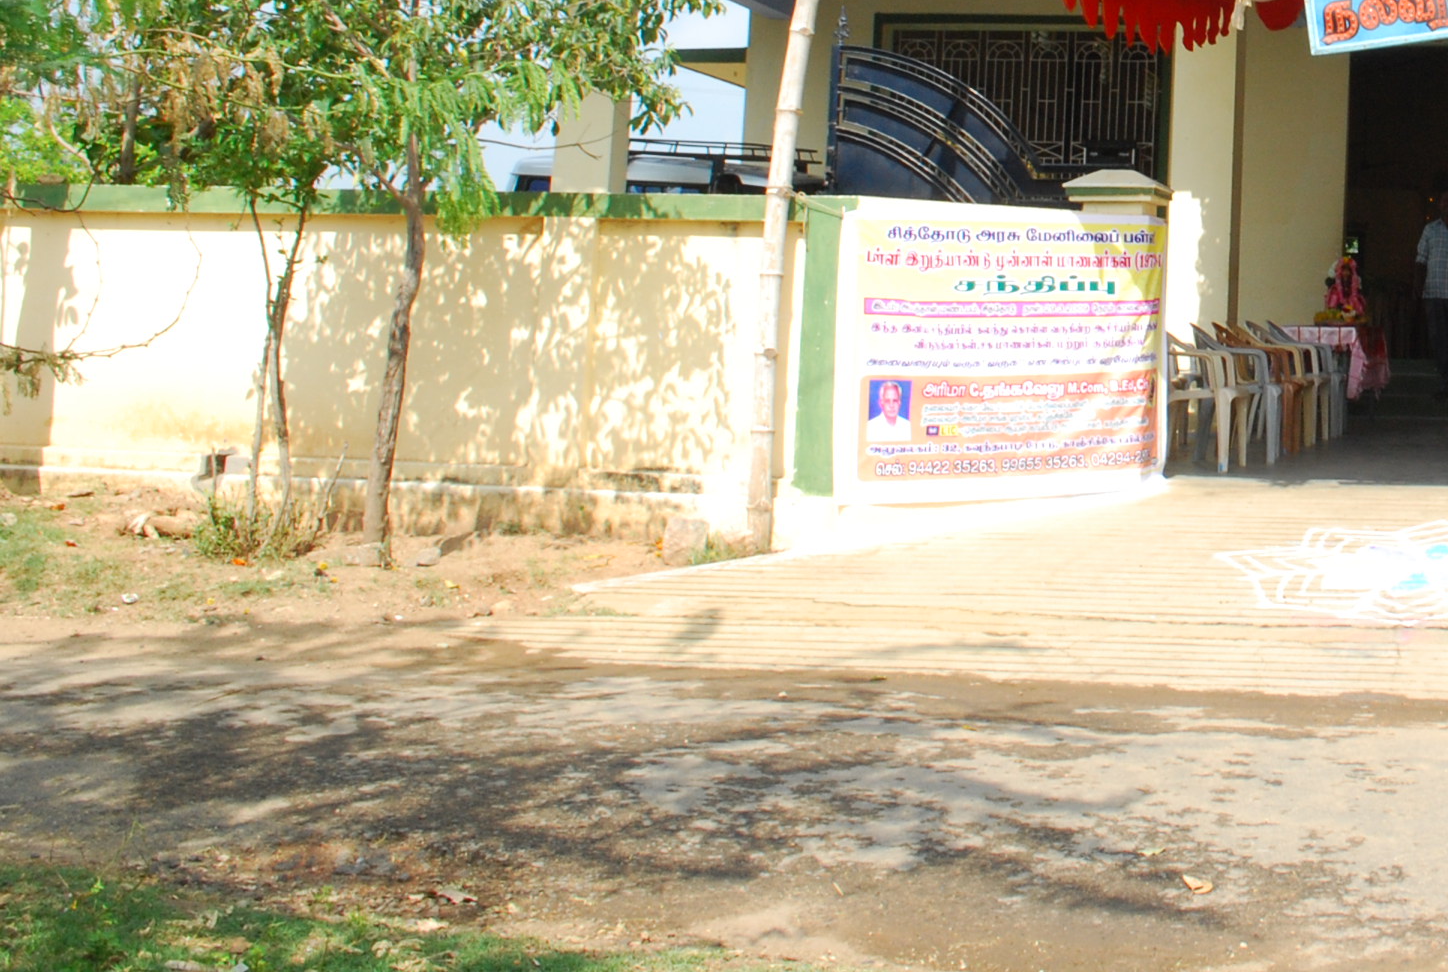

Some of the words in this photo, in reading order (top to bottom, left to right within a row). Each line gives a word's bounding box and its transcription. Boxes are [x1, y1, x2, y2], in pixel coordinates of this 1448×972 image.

[887, 225, 972, 243] சித்தோடு
[975, 228, 1021, 243] அரசு
[954, 274, 1117, 296] சந்திப்பு
[908, 460, 950, 475] 94422
[1001, 457, 1043, 472] 99655
